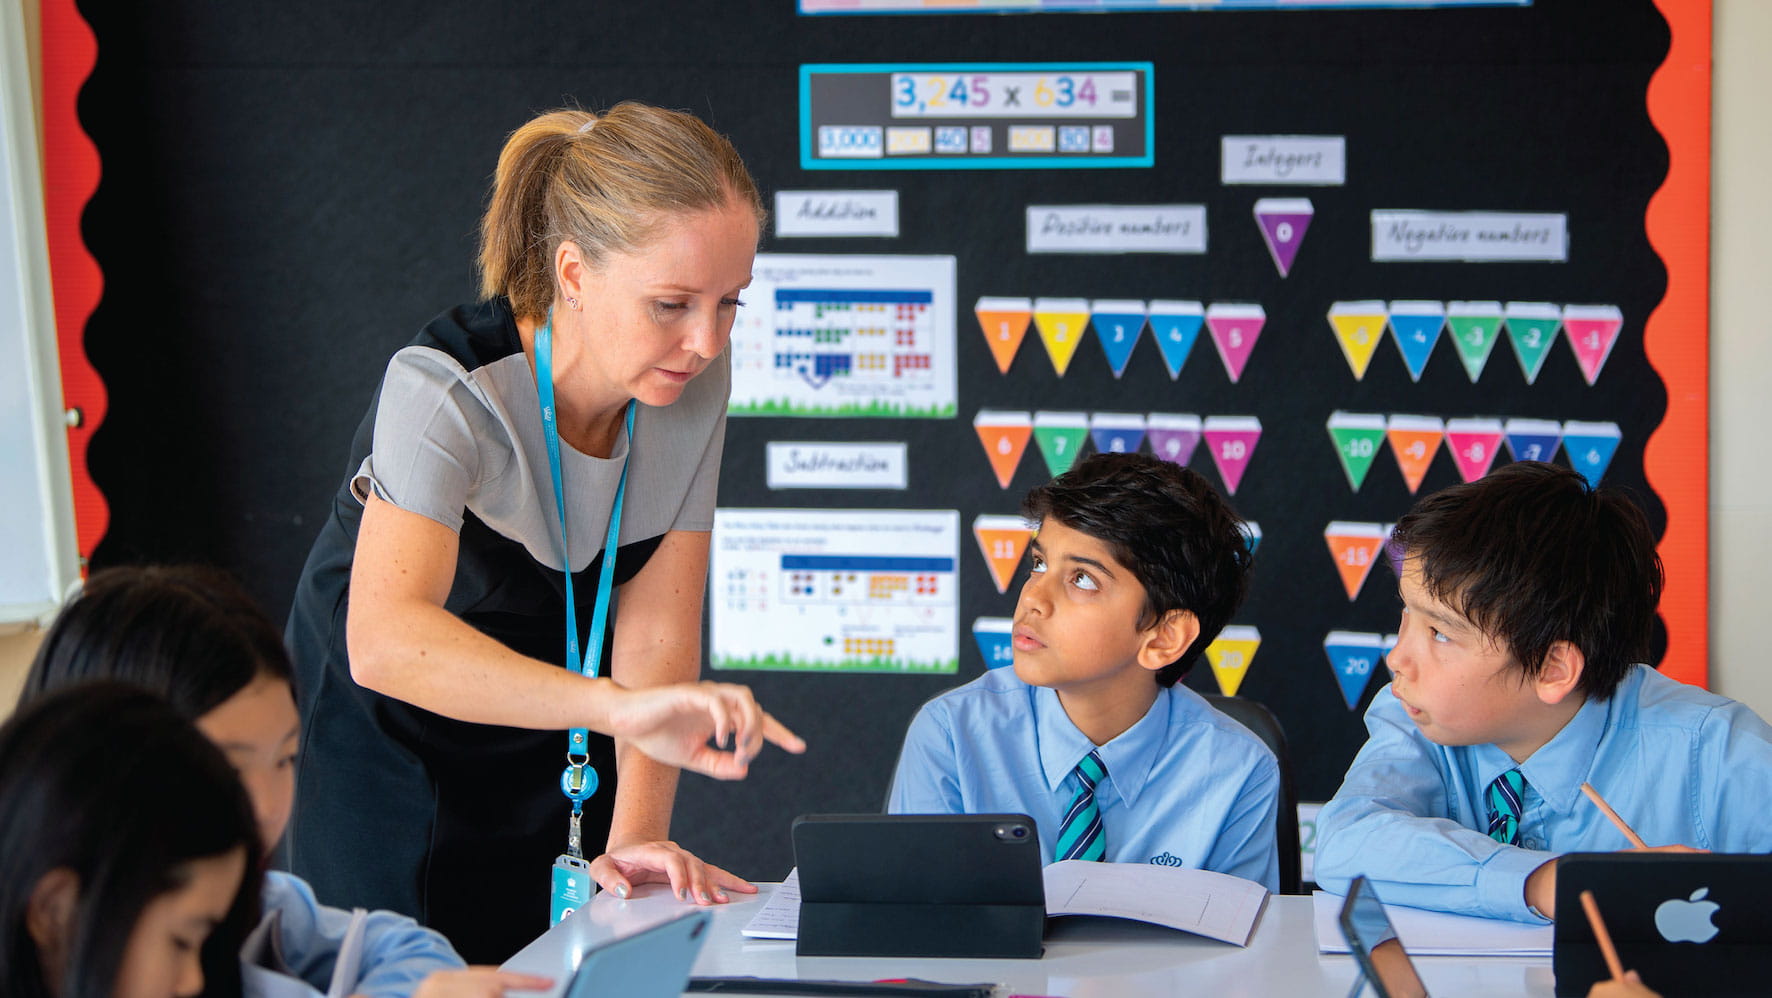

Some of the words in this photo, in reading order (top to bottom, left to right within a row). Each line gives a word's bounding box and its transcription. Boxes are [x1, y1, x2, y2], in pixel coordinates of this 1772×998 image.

[896, 76, 990, 111] 3,245
[1033, 76, 1097, 107] 634
[823, 127, 880, 151] 3,000
[1244, 138, 1323, 176] Integers
[796, 196, 876, 220] Addition
[1041, 212, 1113, 236] Positive
[1119, 215, 1191, 236] numbers
[1276, 222, 1293, 243] 0
[1388, 220, 1470, 253] Negative
[1477, 222, 1551, 244] numbers
[1000, 322, 1011, 341] 1
[1055, 322, 1068, 343] 2
[1113, 325, 1124, 343] 3
[1169, 327, 1182, 343] 4
[1229, 328, 1243, 348] 5
[1466, 326, 1484, 347] -3
[1523, 328, 1541, 349] -2
[999, 436, 1012, 455] 6
[1055, 436, 1067, 455] 7
[1166, 438, 1181, 457] 9
[1222, 440, 1246, 460] 10
[1405, 440, 1426, 460] -9
[1463, 442, 1485, 462] -8
[784, 449, 889, 473] Subtraction
[993, 540, 1014, 559] 11
[1219, 650, 1243, 669] 20
